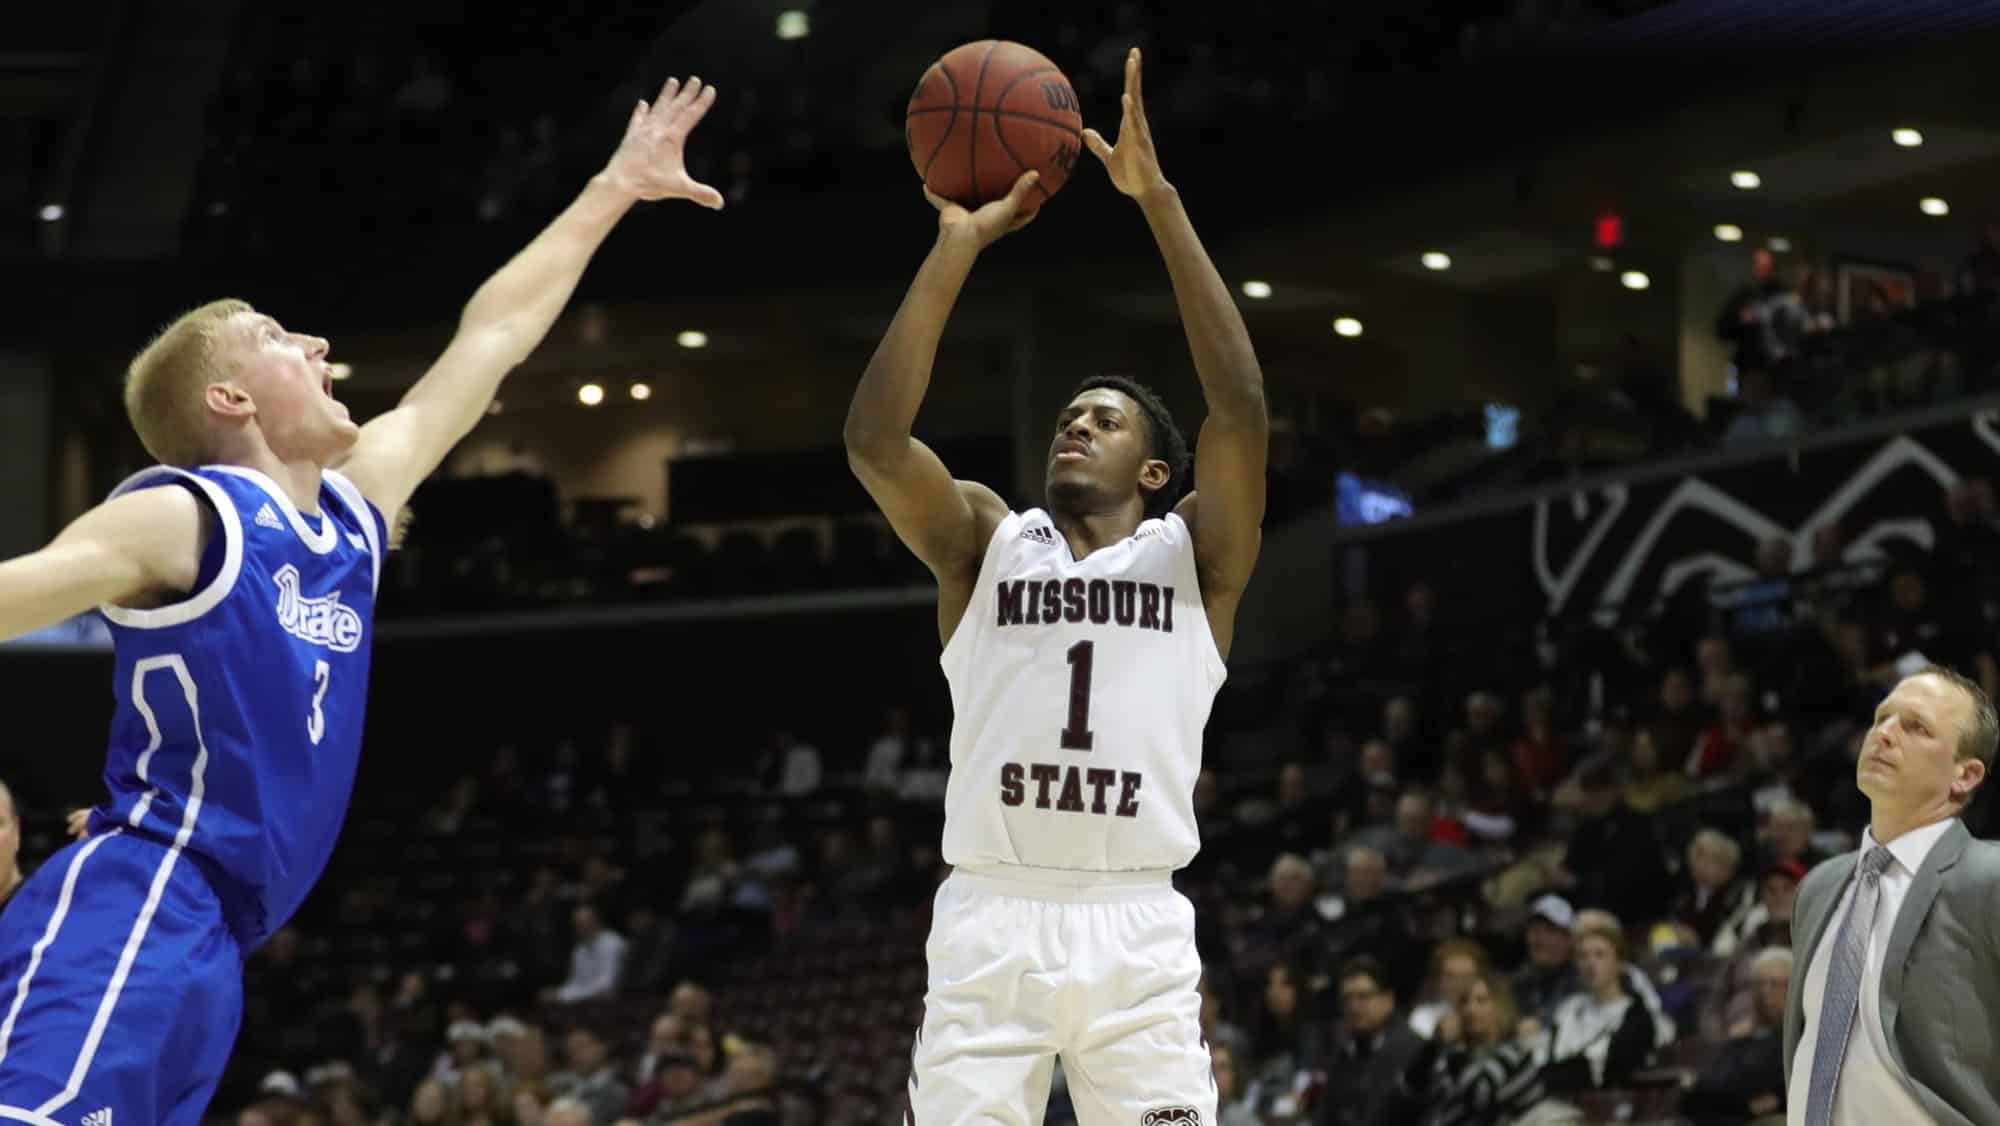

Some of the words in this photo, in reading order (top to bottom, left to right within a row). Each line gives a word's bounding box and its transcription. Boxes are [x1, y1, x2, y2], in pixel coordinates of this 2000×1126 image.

[1019, 531, 1056, 545] adidas
[273, 563, 362, 652] Drake
[997, 577, 1174, 632] MISSOURI
[307, 659, 330, 745] 3
[1060, 640, 1094, 751] 1
[1001, 762, 1142, 817] STATE
